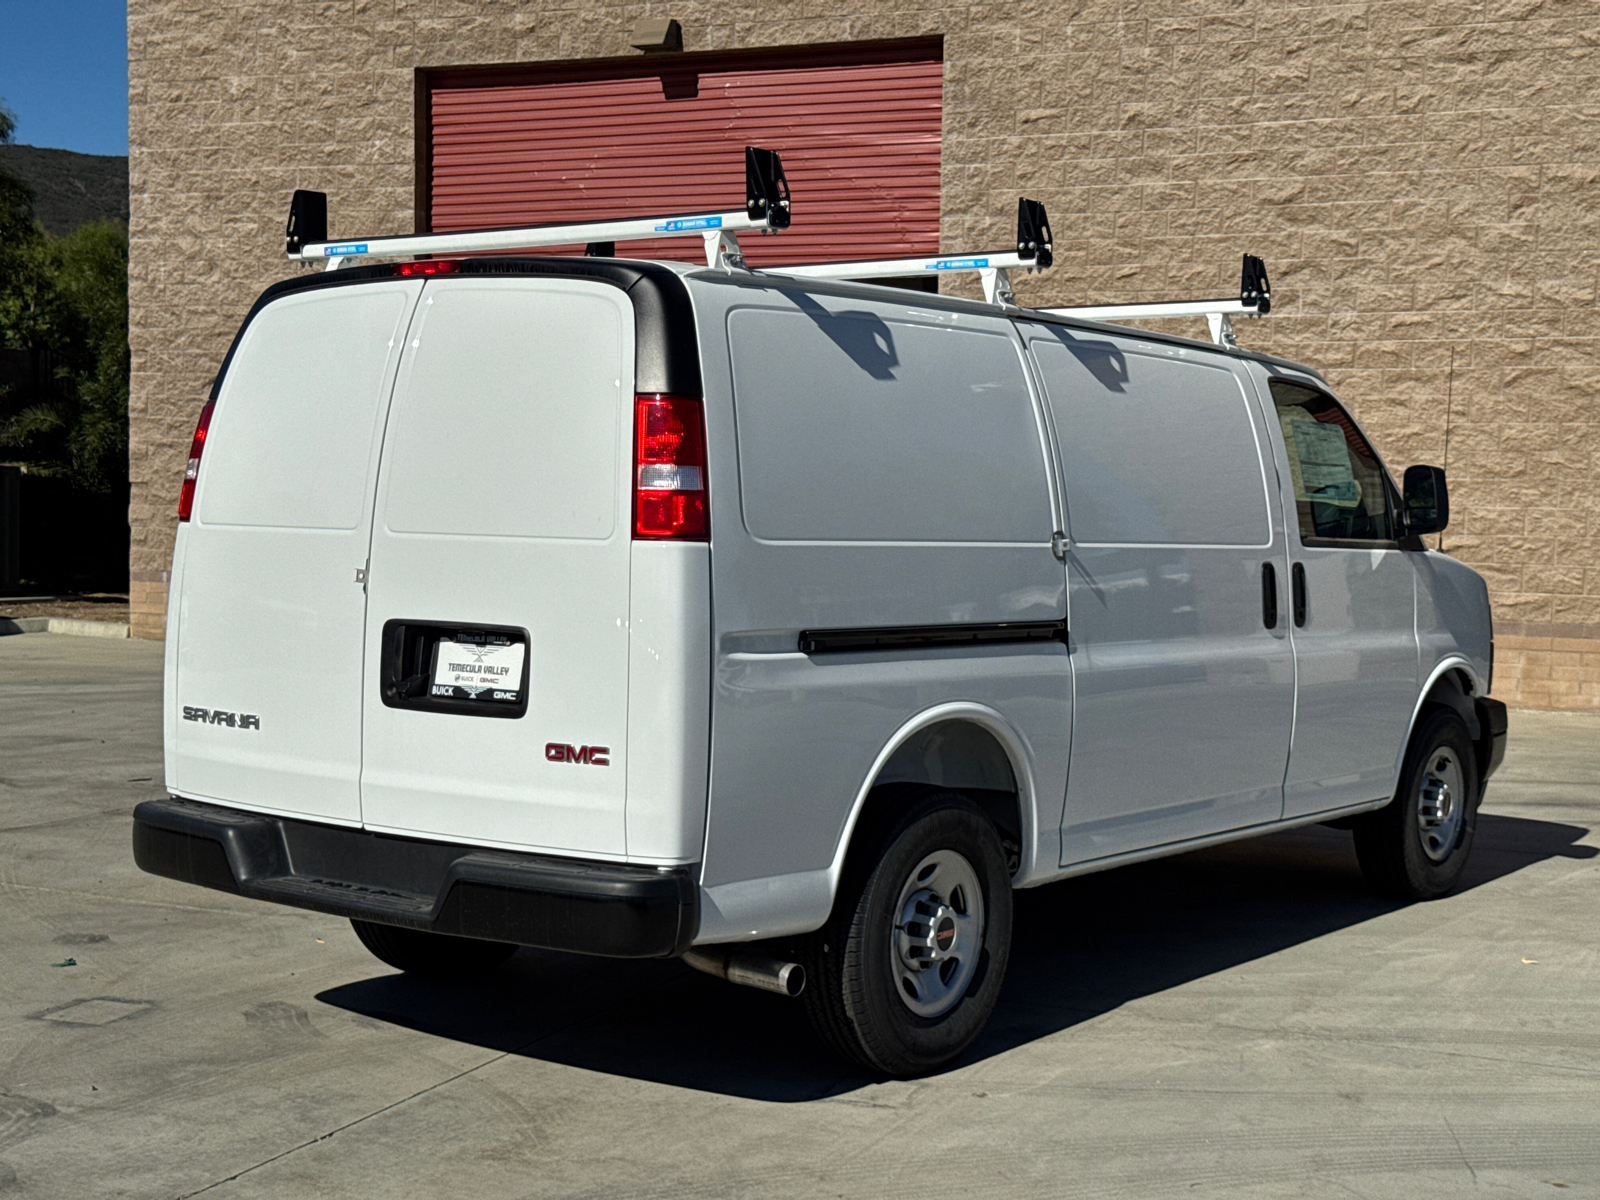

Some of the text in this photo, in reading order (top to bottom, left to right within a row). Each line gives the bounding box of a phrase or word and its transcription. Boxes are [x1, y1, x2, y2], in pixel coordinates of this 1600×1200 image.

[448, 663, 510, 676] TEMECULA VALLEY
[432, 686, 454, 697] BUICK
[493, 691, 517, 700] GMC
[183, 706, 260, 730] SAVANA
[545, 742, 610, 766] GMC
